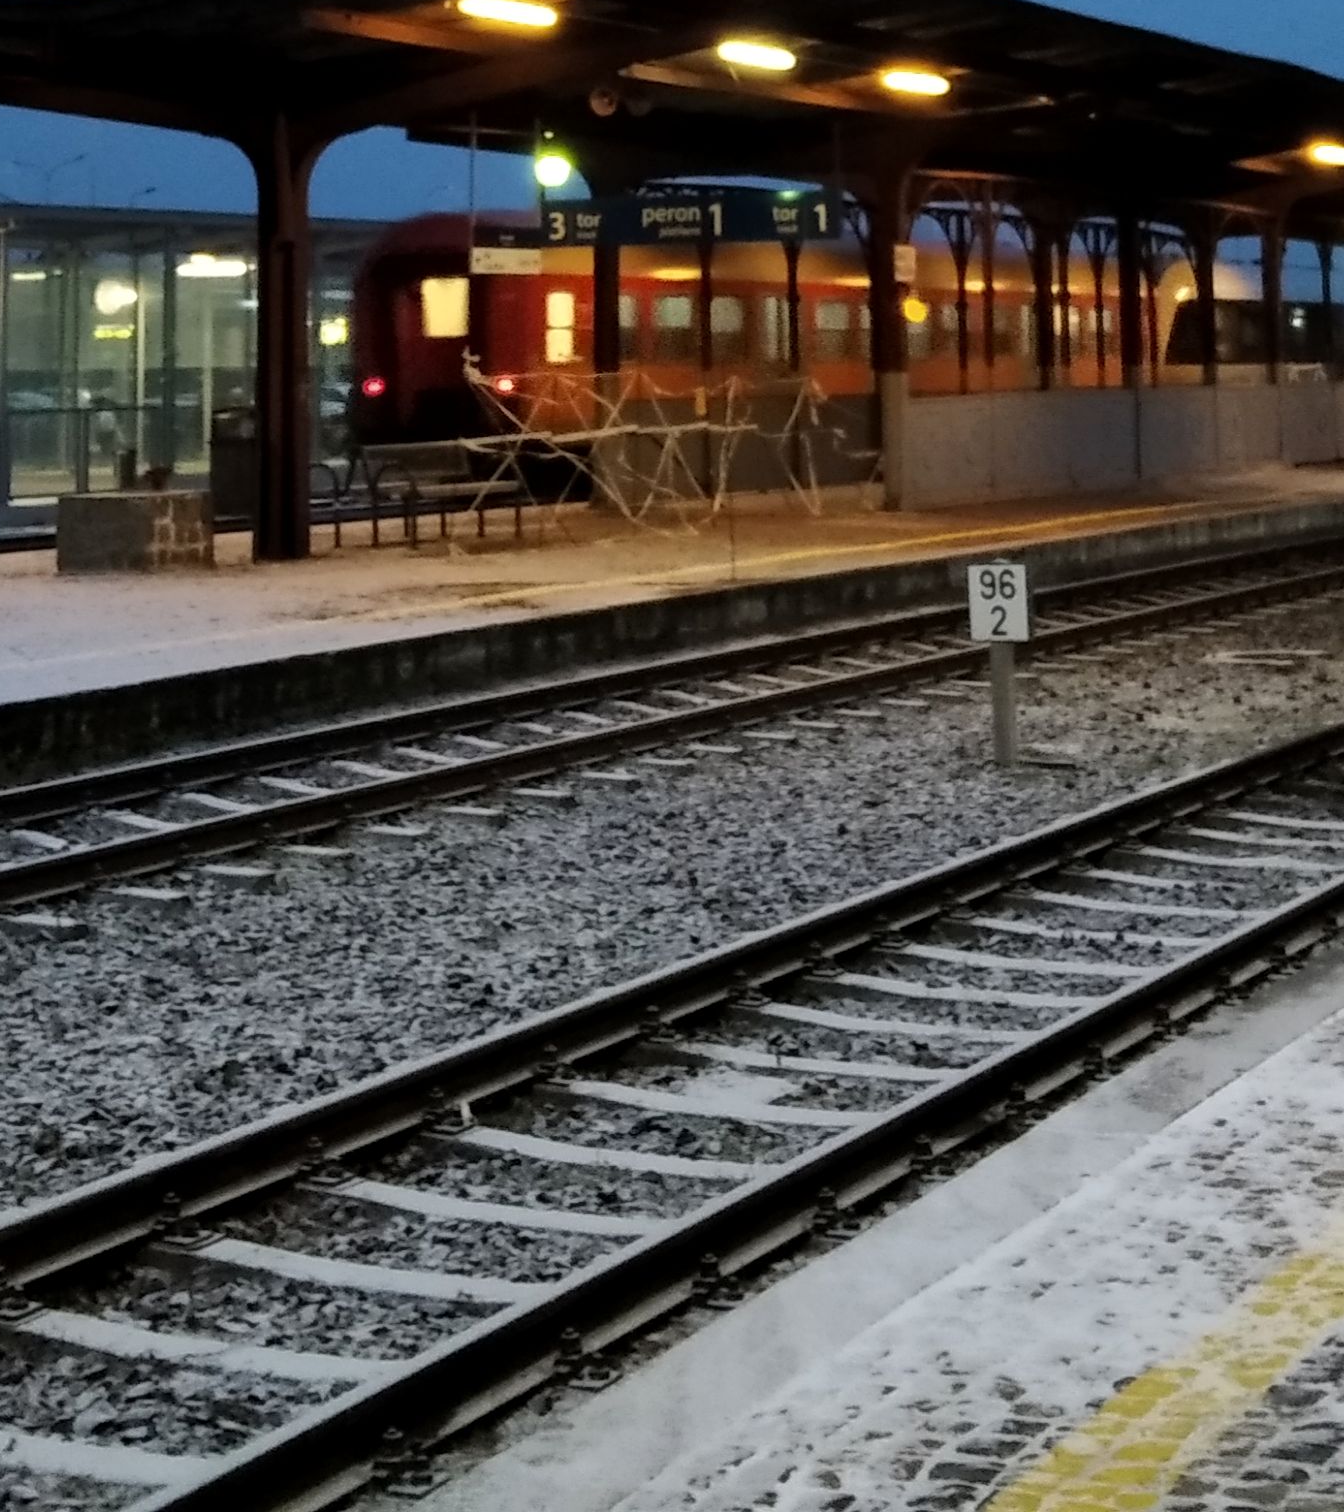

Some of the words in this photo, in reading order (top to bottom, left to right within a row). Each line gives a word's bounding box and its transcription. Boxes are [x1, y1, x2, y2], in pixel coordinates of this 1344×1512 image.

[548, 211, 566, 240] 3
[576, 213, 602, 228] tor
[641, 205, 701, 227] peron
[708, 203, 722, 236] 1
[772, 206, 798, 221] tor
[813, 203, 827, 232] 1
[980, 569, 1016, 600] 96
[990, 605, 1008, 636] 2
